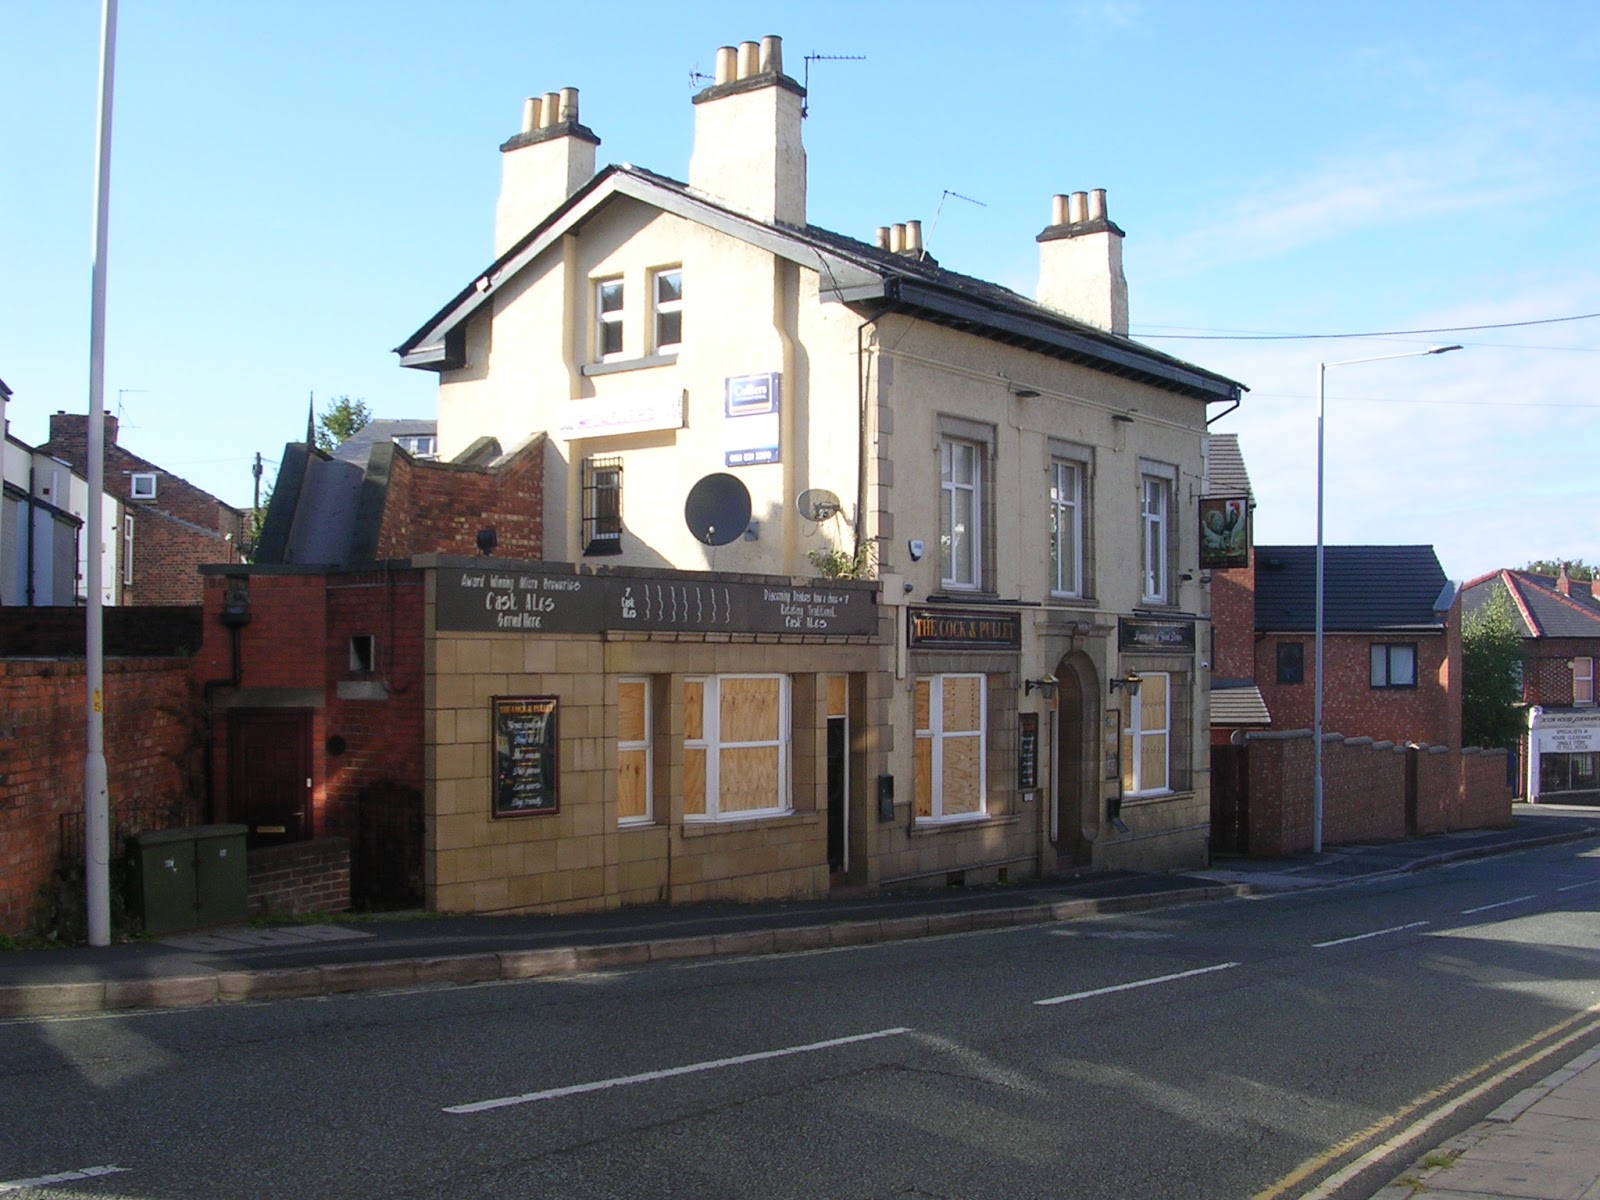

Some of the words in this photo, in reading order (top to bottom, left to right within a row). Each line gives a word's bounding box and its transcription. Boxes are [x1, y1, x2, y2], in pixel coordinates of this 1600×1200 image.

[461, 574, 485, 588] Award
[490, 575, 514, 592] Winning
[519, 576, 538, 590] Micro
[543, 577, 581, 591] Breweries
[916, 618, 937, 637] THE
[940, 621, 966, 638] COCK
[969, 622, 976, 638] &
[980, 622, 1014, 638] PULLET
